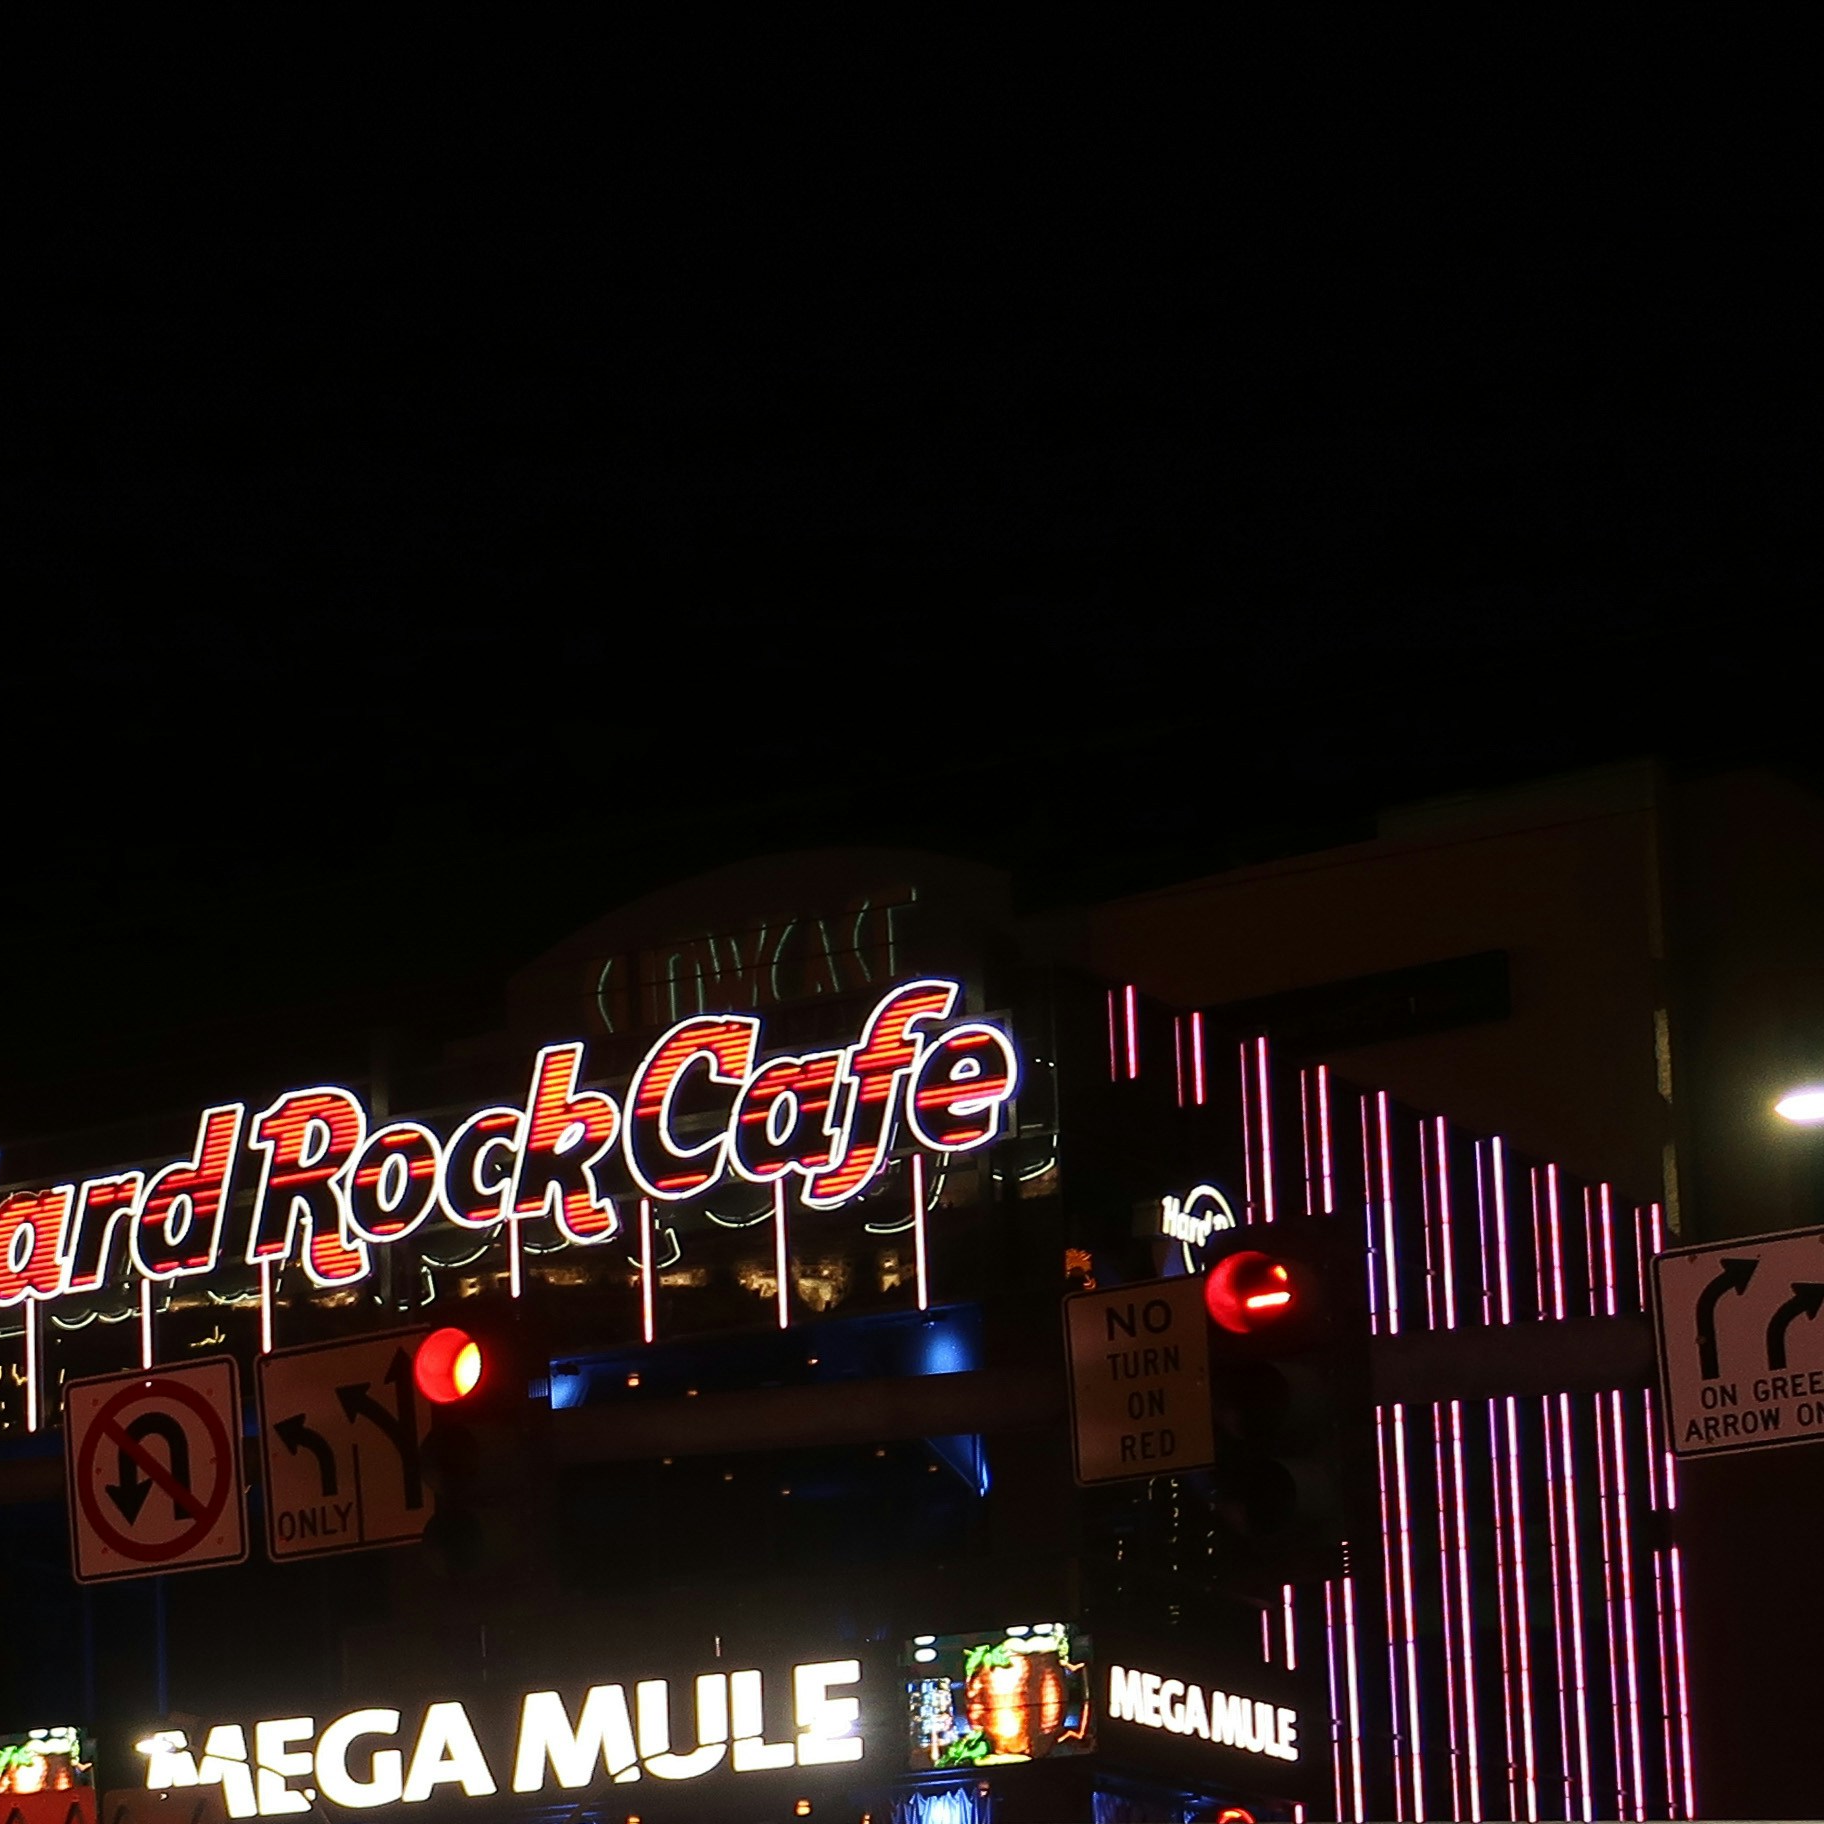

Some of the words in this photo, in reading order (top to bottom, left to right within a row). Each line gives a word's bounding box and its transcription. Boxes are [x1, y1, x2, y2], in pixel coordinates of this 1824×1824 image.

[247, 1041, 623, 1286] Rock
[622, 981, 1018, 1206] Cafe
[1106, 1300, 1172, 1341] NO
[1107, 1345, 1180, 1381] TURN
[1127, 1388, 1166, 1420] ON
[1702, 1384, 1737, 1409] ON
[1754, 1371, 1824, 1402] GREE
[1685, 1407, 1780, 1442] ARROW
[1120, 1428, 1176, 1462] RED
[278, 1502, 353, 1541] ONLY
[1109, 1665, 1210, 1740] MEGA
[1210, 1690, 1298, 1762] MULE
[138, 1698, 496, 1818] MEGA
[512, 1658, 864, 1790] MULE
